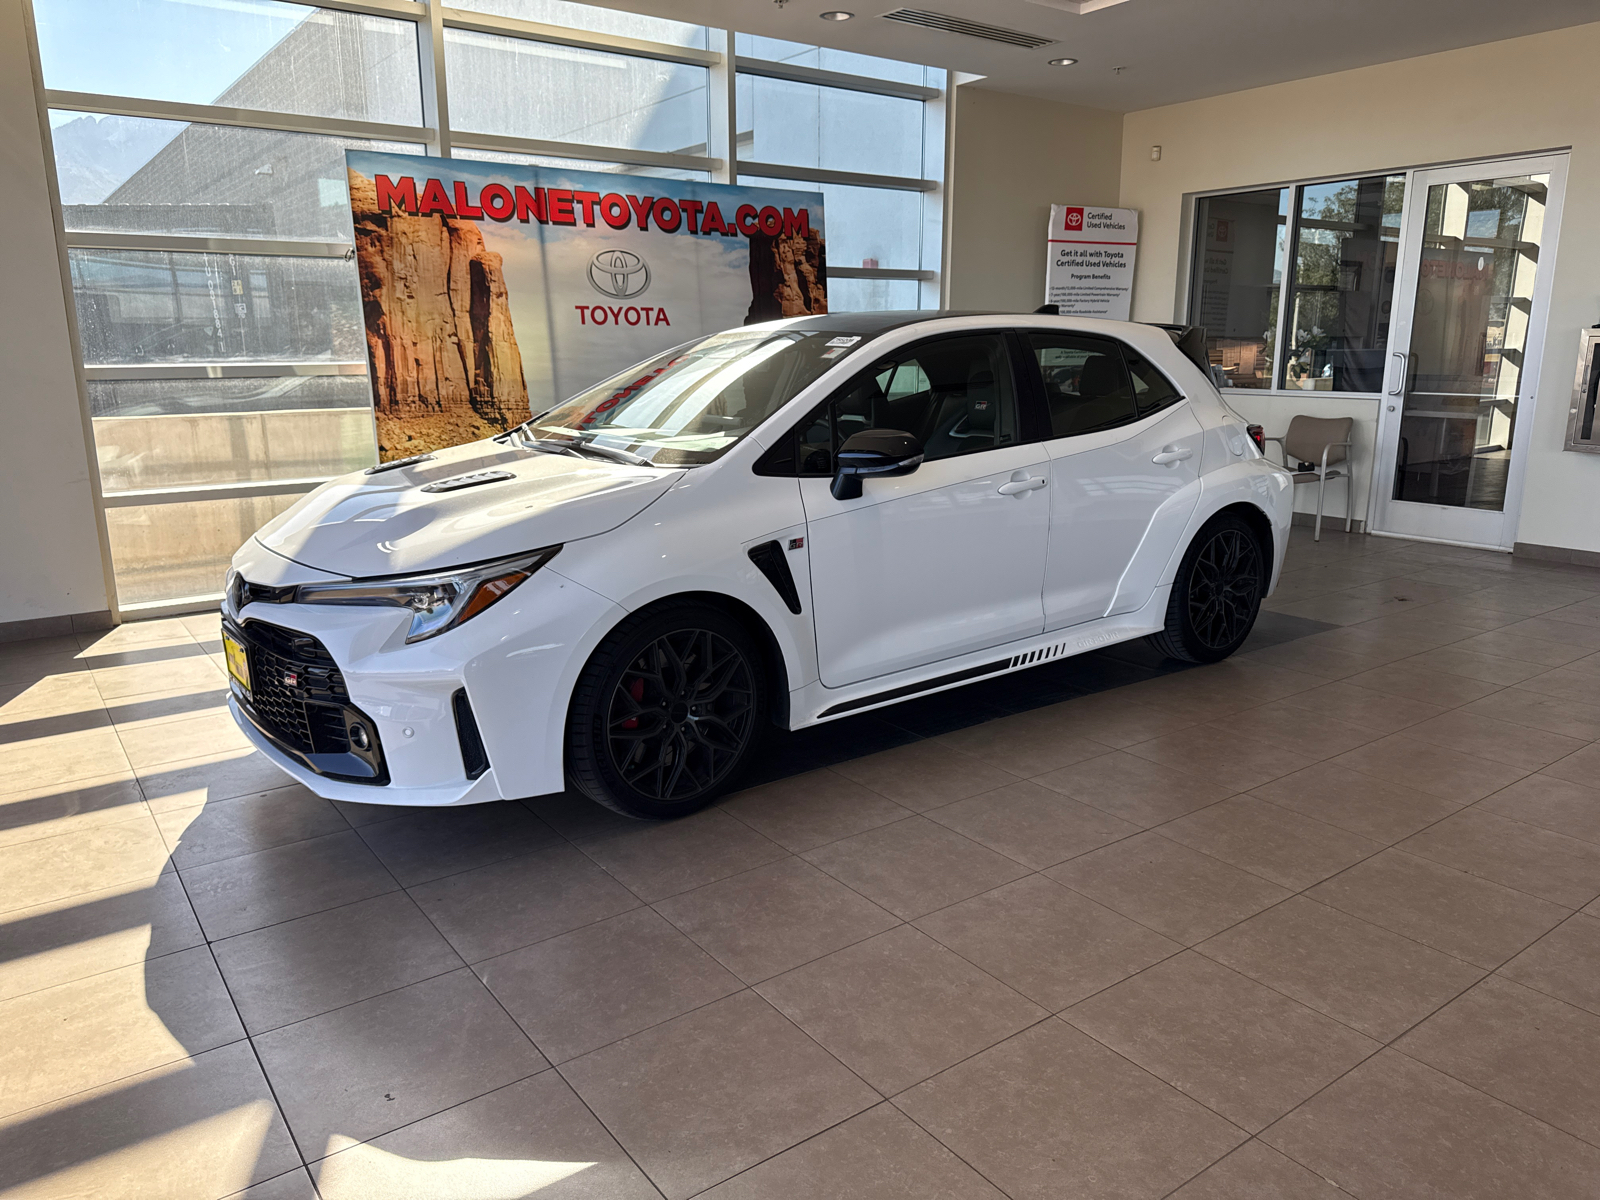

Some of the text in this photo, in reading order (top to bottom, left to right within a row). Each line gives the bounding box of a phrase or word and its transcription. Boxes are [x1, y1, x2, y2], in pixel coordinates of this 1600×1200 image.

[375, 174, 810, 238] MALONETOYOTA.COM
[1087, 212, 1113, 221] Certified
[1087, 221, 1126, 230] Used Vehicles
[1060, 249, 1124, 260] Get it all with Toyota
[1056, 259, 1127, 269] Certified Used Vehicles
[575, 305, 671, 327] TOYOTA
